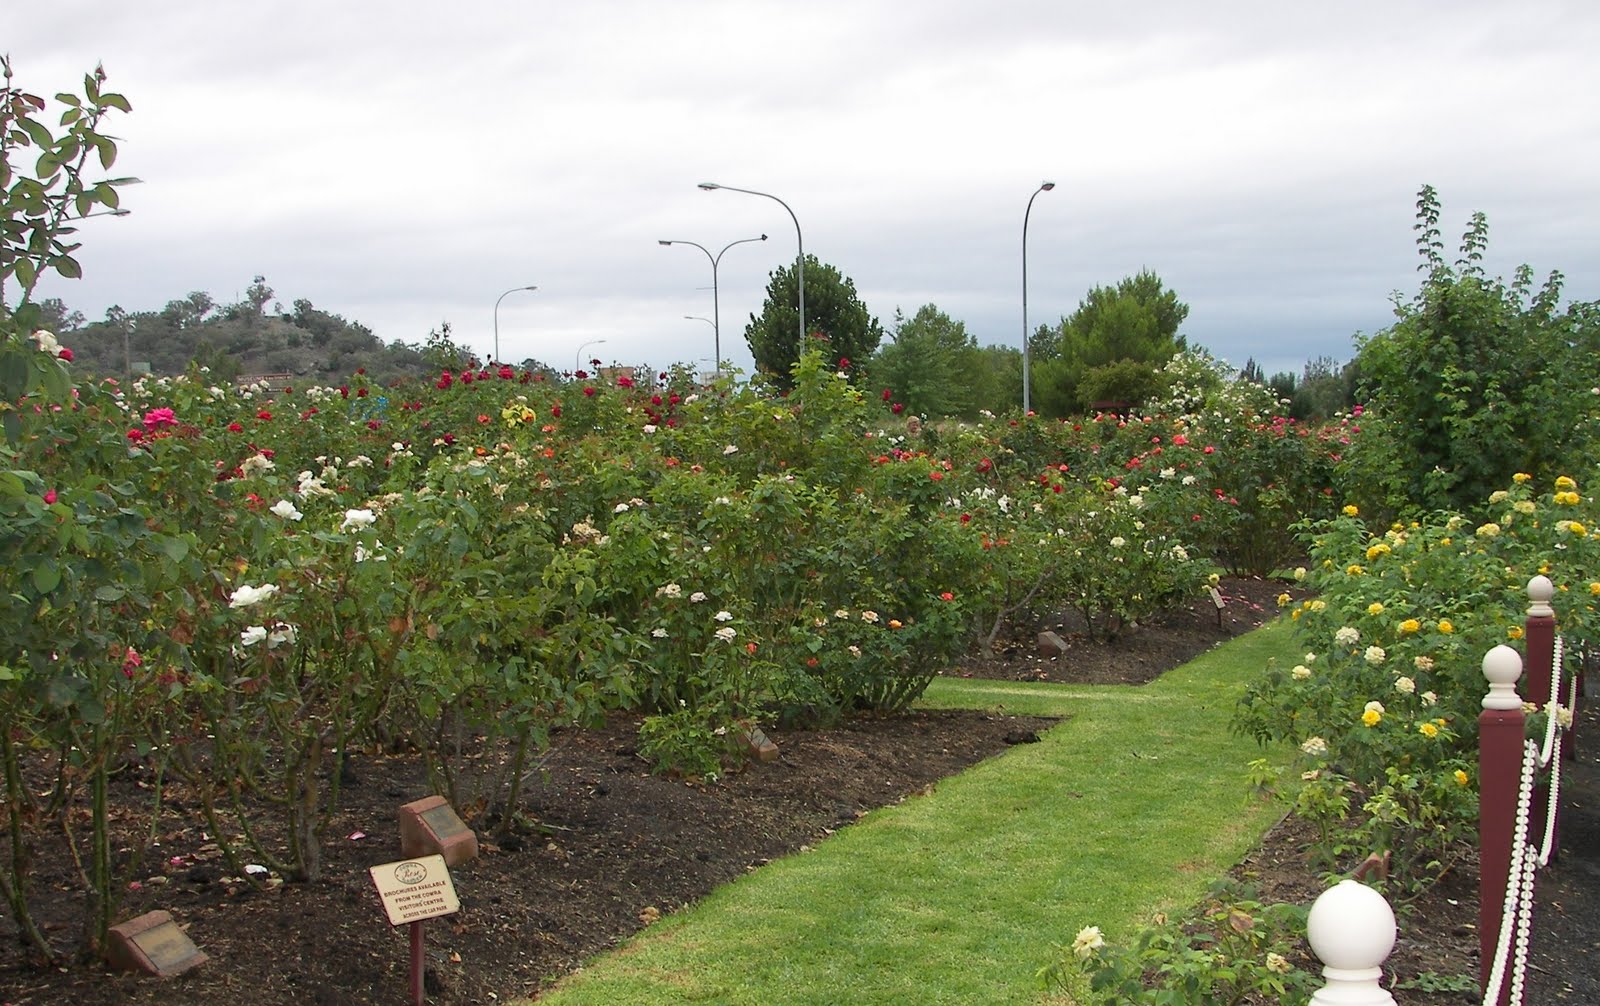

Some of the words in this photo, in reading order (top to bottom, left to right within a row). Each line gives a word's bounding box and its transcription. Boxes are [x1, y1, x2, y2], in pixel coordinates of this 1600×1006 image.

[384, 886, 418, 898] BROCHURES
[418, 880, 446, 891] AVAILABLE
[422, 890, 442, 898] COWRA
[423, 898, 444, 906] CENTRE
[402, 910, 420, 919] ACROSS
